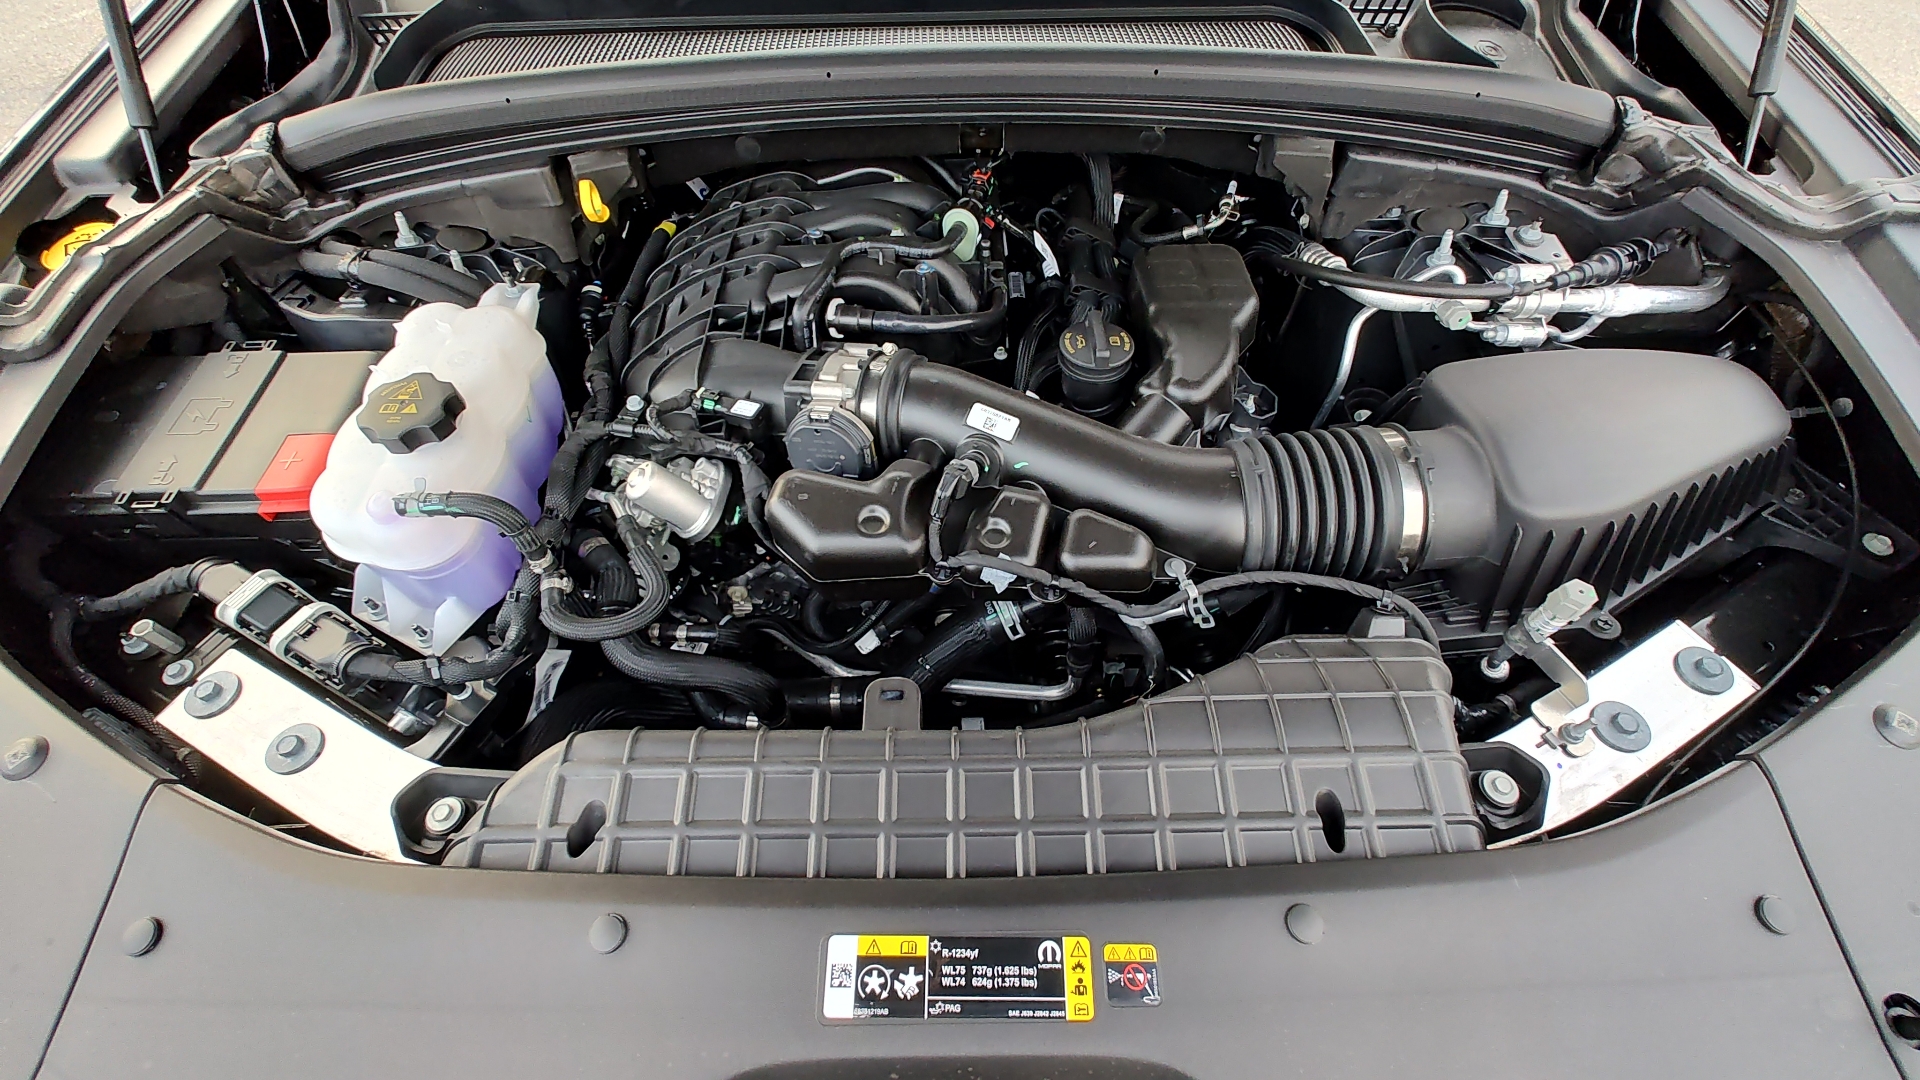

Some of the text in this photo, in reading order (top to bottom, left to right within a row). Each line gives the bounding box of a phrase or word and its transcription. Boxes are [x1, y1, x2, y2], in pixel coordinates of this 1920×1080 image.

[941, 948, 979, 960] R-1234yf
[941, 965, 1037, 977] WL75 737g (1.625 lbs)
[941, 977, 1037, 989] WL74 624g (1.375 lbs)
[944, 1004, 961, 1013] PAG
